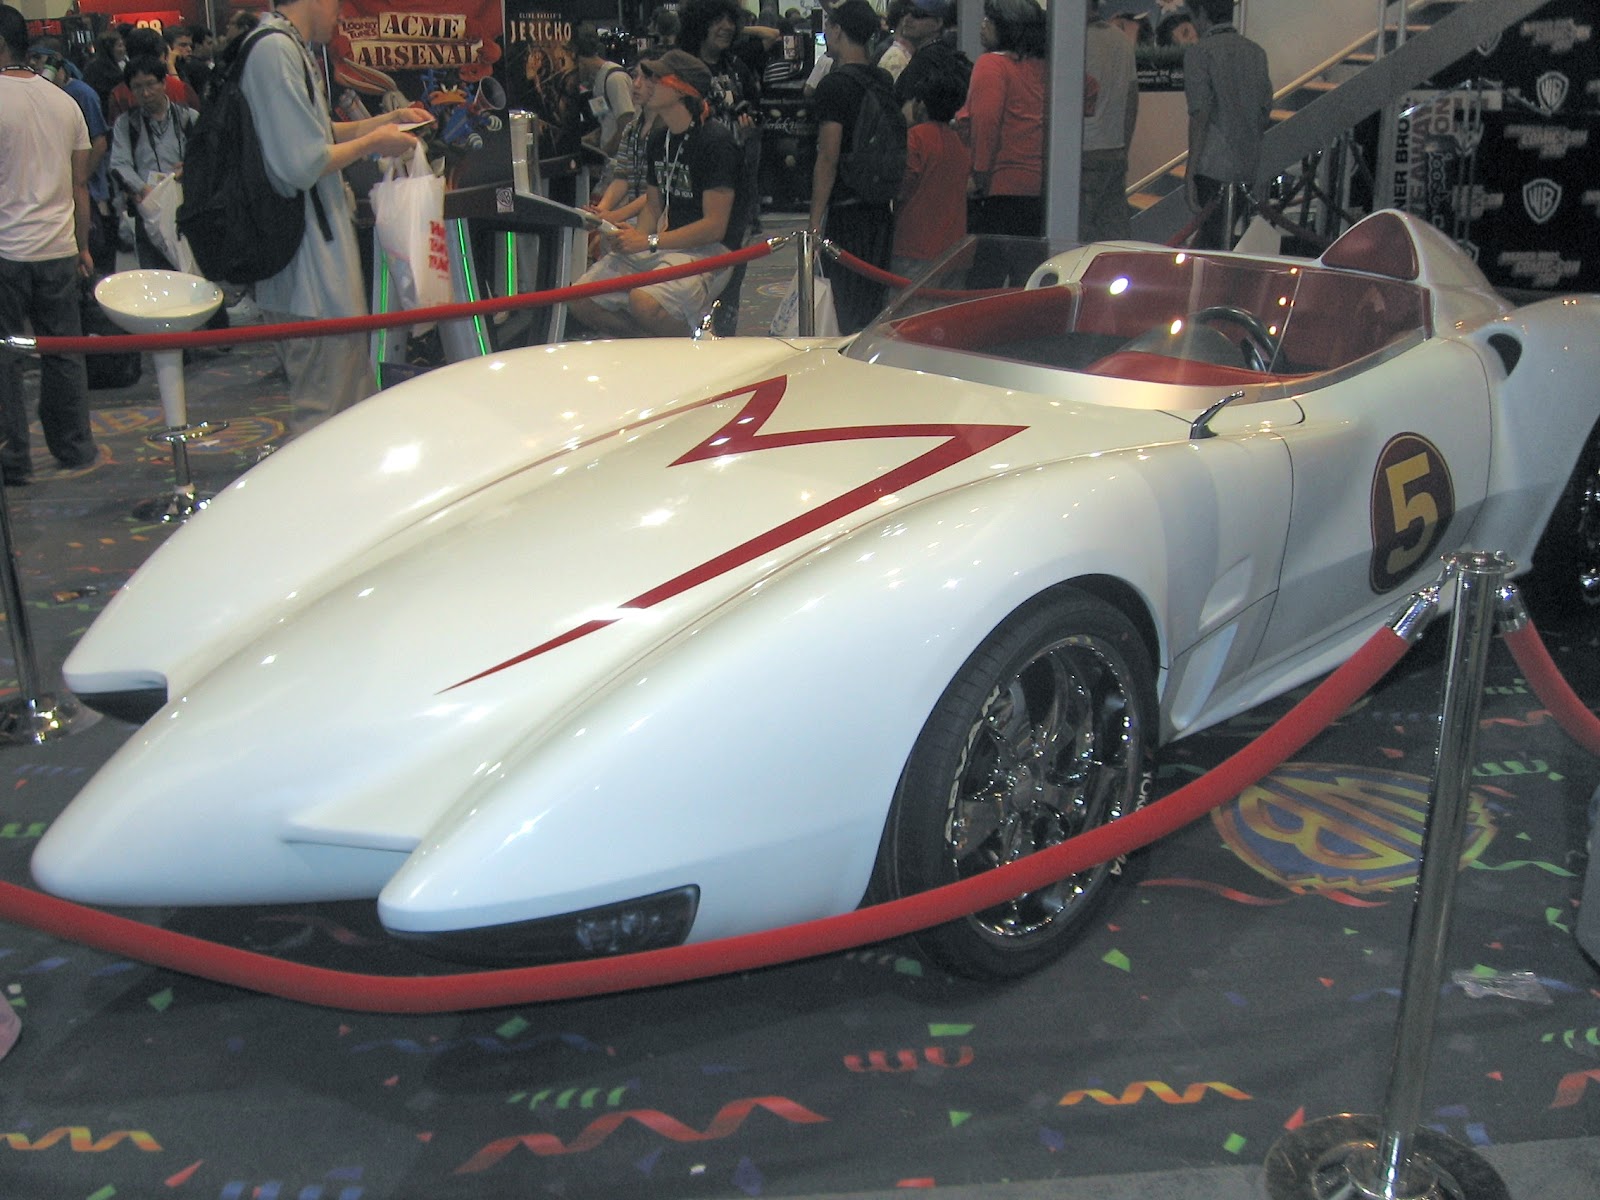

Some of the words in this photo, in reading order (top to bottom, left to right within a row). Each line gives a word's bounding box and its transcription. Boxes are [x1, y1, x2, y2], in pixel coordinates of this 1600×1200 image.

[383, 14, 459, 39] ACME
[510, 21, 572, 42] JERICHO
[358, 44, 479, 67] ARSENAL
[1385, 452, 1438, 575] 5
